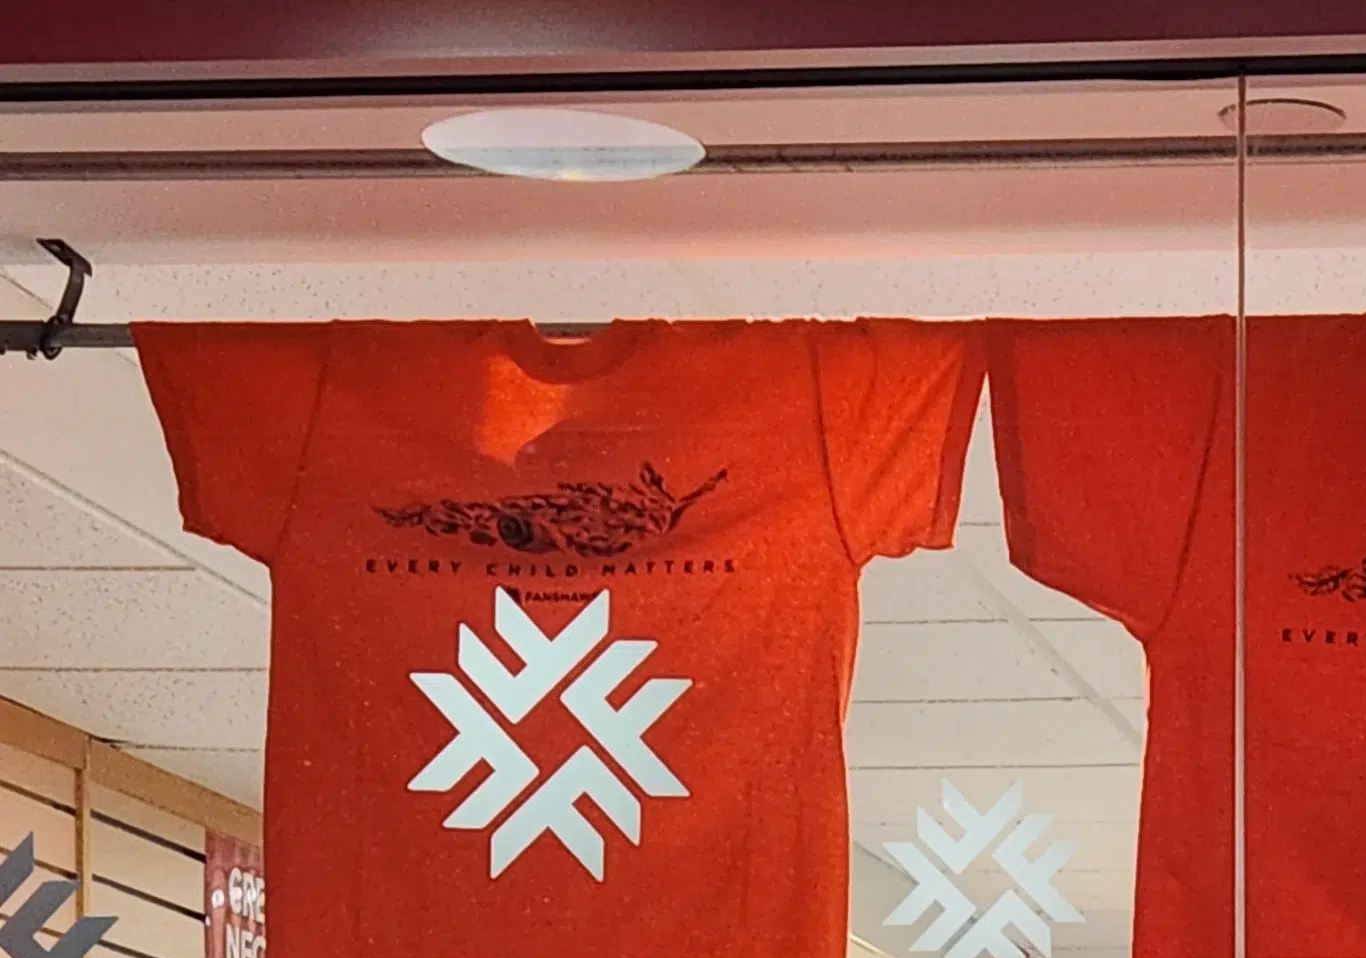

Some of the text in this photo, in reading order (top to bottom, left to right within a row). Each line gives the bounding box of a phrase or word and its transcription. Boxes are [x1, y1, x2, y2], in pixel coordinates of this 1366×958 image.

[365, 559, 735, 578] EVERY CHILD MATTERS
